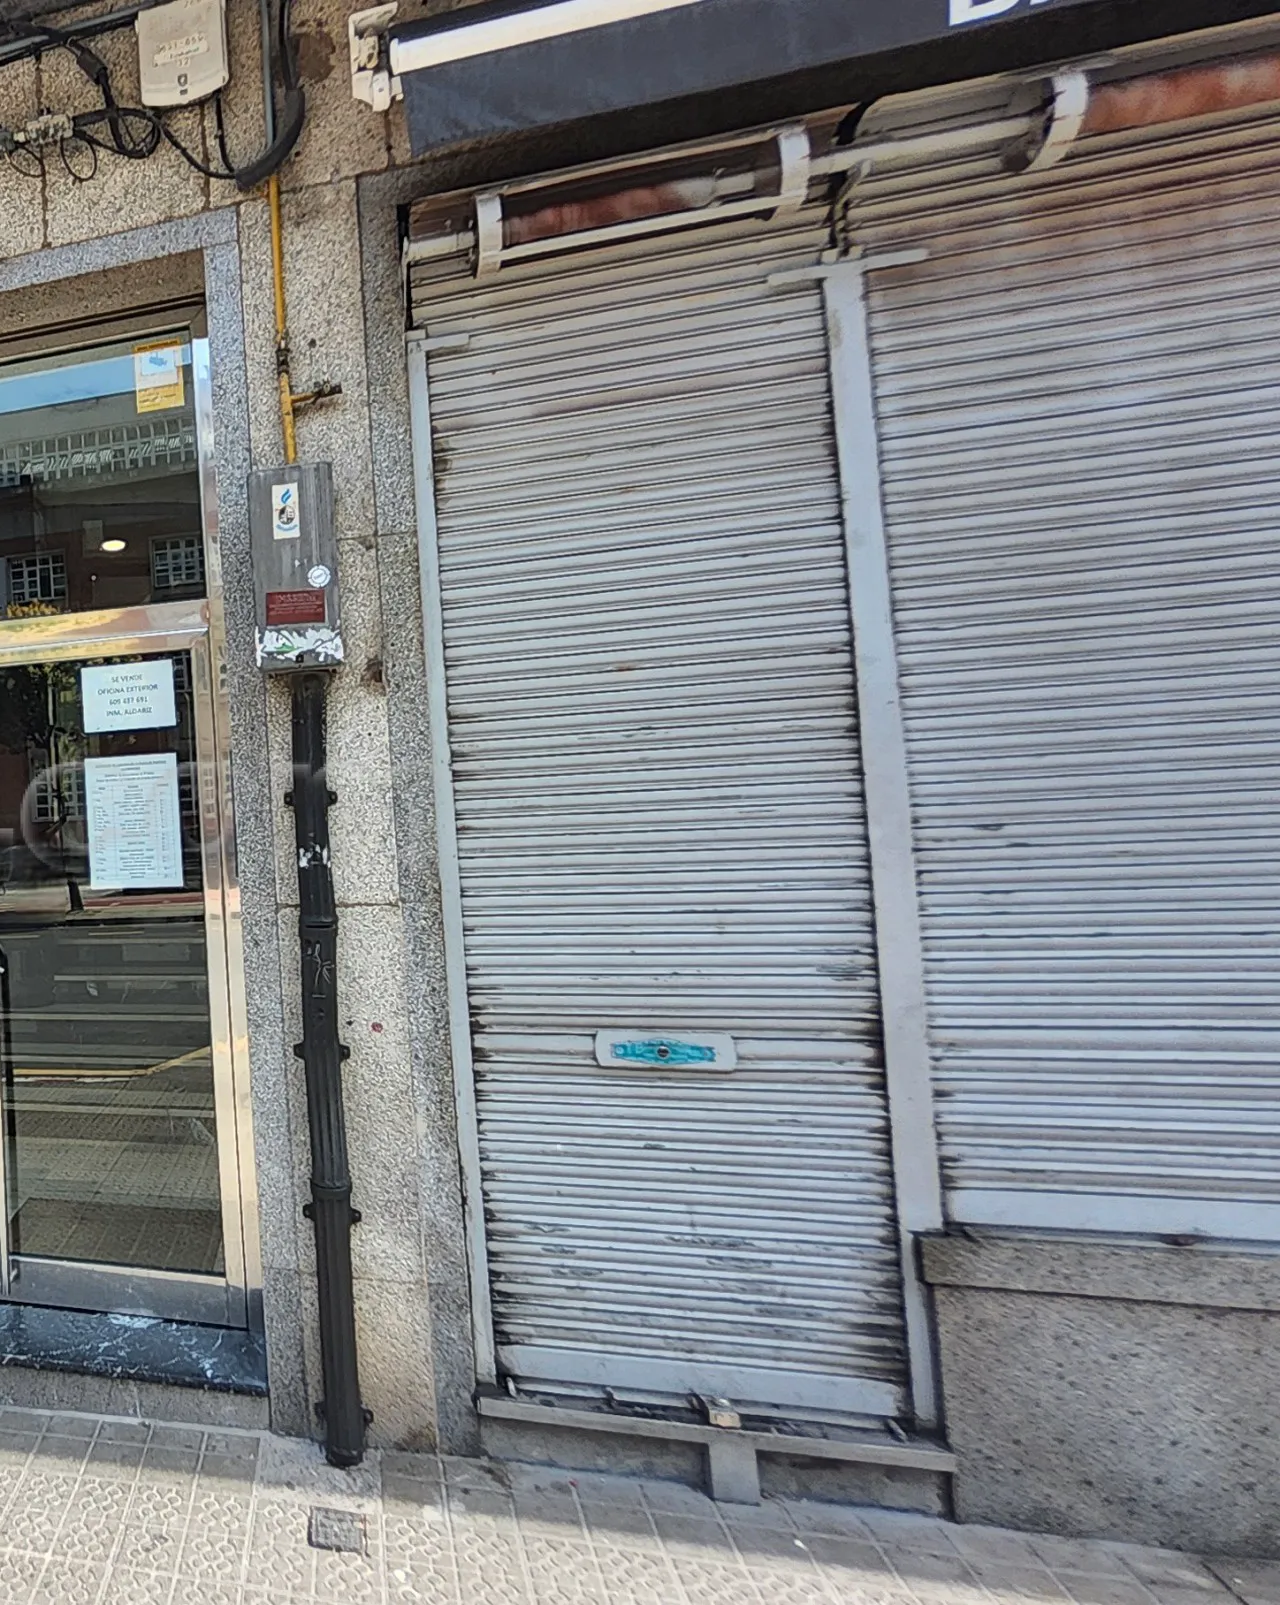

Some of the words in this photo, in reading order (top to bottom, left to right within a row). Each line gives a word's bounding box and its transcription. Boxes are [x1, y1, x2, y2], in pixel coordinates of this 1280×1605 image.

[120, 674, 142, 682] VENDE
[97, 687, 125, 695] OFICINA
[126, 684, 158, 693] EXTERIOR
